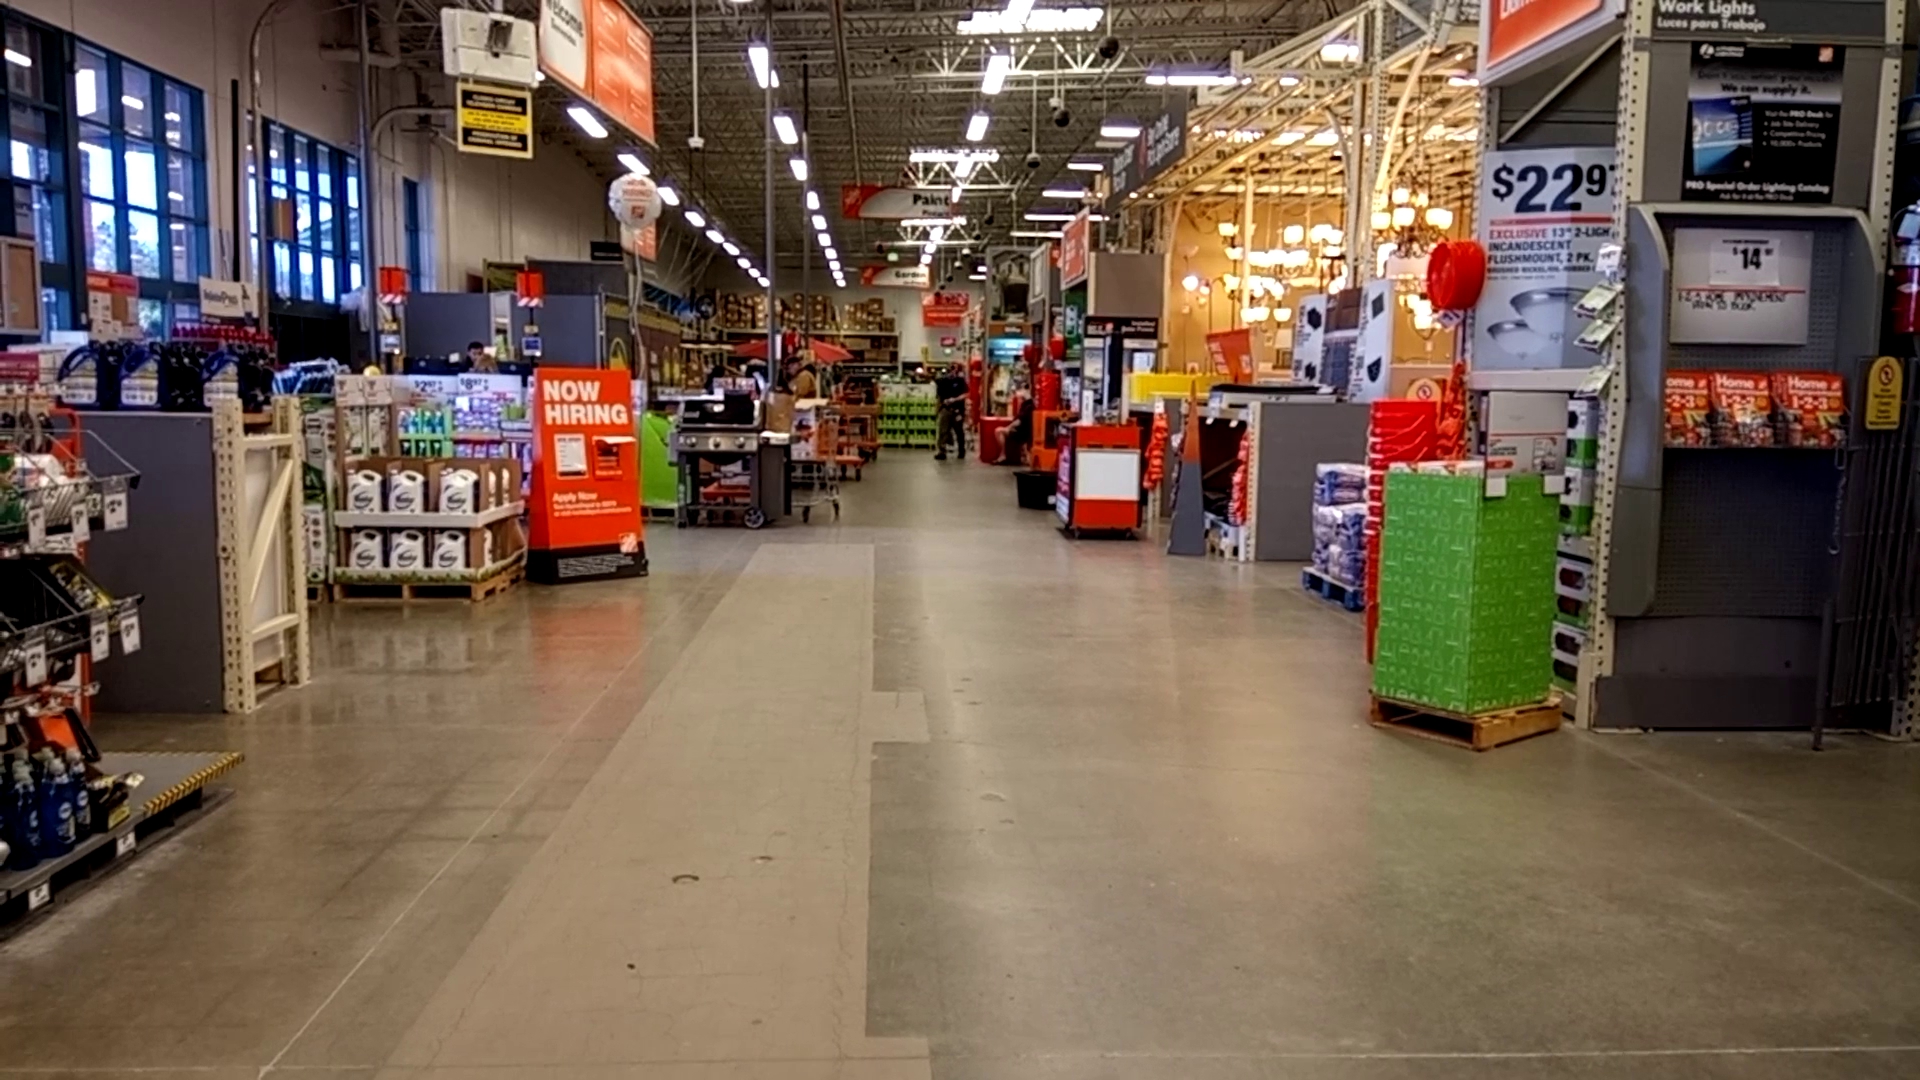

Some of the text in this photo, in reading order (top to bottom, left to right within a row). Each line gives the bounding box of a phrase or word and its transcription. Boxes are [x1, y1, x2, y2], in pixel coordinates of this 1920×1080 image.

[1659, 0, 1756, 17] Work Lights
[1657, 17, 1766, 33] Luces para Trabajo
[1721, 82, 1812, 95] We can supply it.
[1491, 162, 1616, 213] $229
[1685, 180, 1830, 194] PRO Special Order Lighting Catalog
[913, 194, 949, 206] Paint
[1489, 227, 1612, 240] EXCLUSIVE 13" 2-LIGH
[1488, 240, 1572, 251] INCANDESCENT
[1487, 252, 1564, 264] FLUSHMOUNT,
[1566, 252, 1574, 262] 2
[1576, 252, 1594, 263] PK.
[895, 271, 927, 279] Garden
[1666, 377, 1695, 388] ome
[1715, 373, 1755, 389] Home
[1788, 376, 1828, 389] Home
[543, 380, 600, 401] NOW
[1666, 395, 1695, 408] -2-3
[1793, 396, 1828, 409] 1-2-3
[545, 404, 628, 425] HIRING
